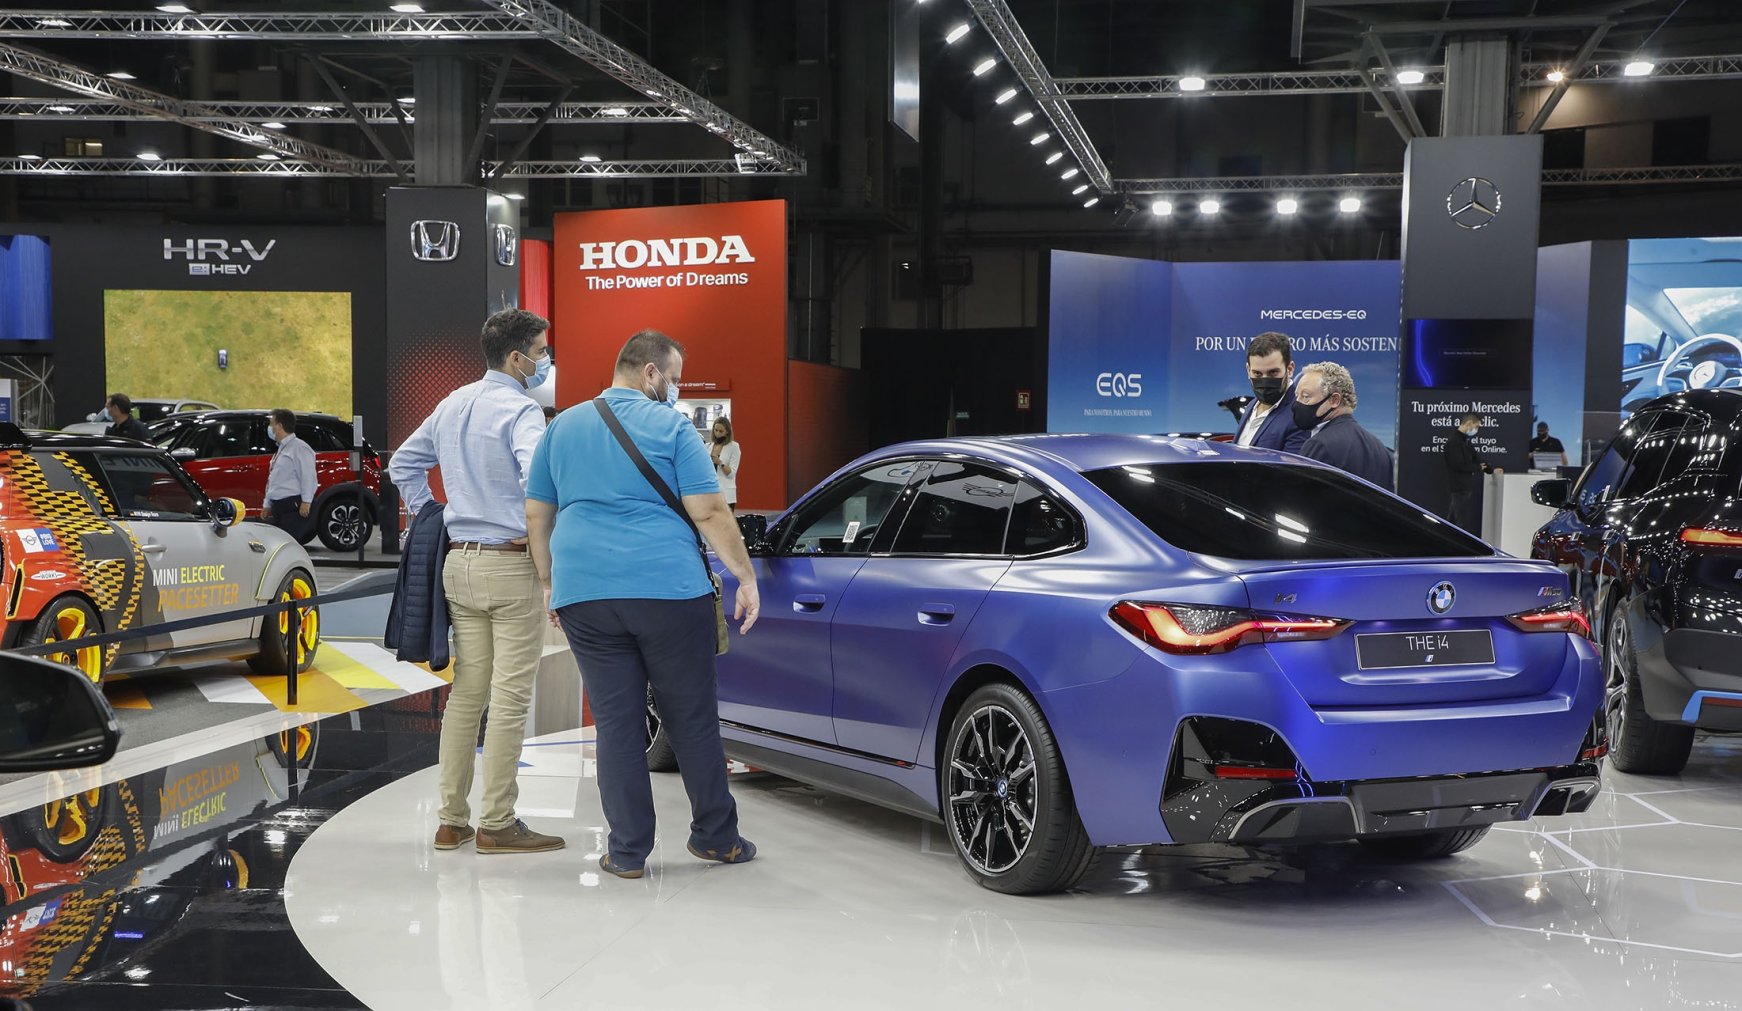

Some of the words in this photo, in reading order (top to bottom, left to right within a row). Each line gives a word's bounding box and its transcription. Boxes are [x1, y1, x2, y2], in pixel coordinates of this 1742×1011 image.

[163, 238, 276, 261] HR-V
[579, 235, 756, 270] HONDA
[585, 276, 614, 290] The
[616, 275, 664, 289] Power
[666, 273, 683, 287] of
[686, 272, 749, 286] Dreams
[1260, 309, 1367, 320] MERCEDES-EQ
[1195, 336, 1224, 351] POR
[1226, 336, 1246, 351] UN
[1309, 333, 1340, 352] MÁS
[1096, 372, 1142, 397] EQS
[1411, 401, 1425, 413] Tu
[1427, 401, 1469, 415] próximo
[1471, 402, 1521, 414] Mercedes
[1431, 415, 1452, 427] está
[1431, 445, 1439, 453] el
[1481, 445, 1508, 454] Online.
[1471, 436, 1478, 444] el
[1479, 437, 1496, 446] tuyo
[152, 568, 178, 587] MINI
[180, 564, 225, 585] ELECTRIC
[158, 583, 239, 612] PACESETTER
[1405, 635, 1435, 651] THE
[1437, 634, 1449, 650] i4
